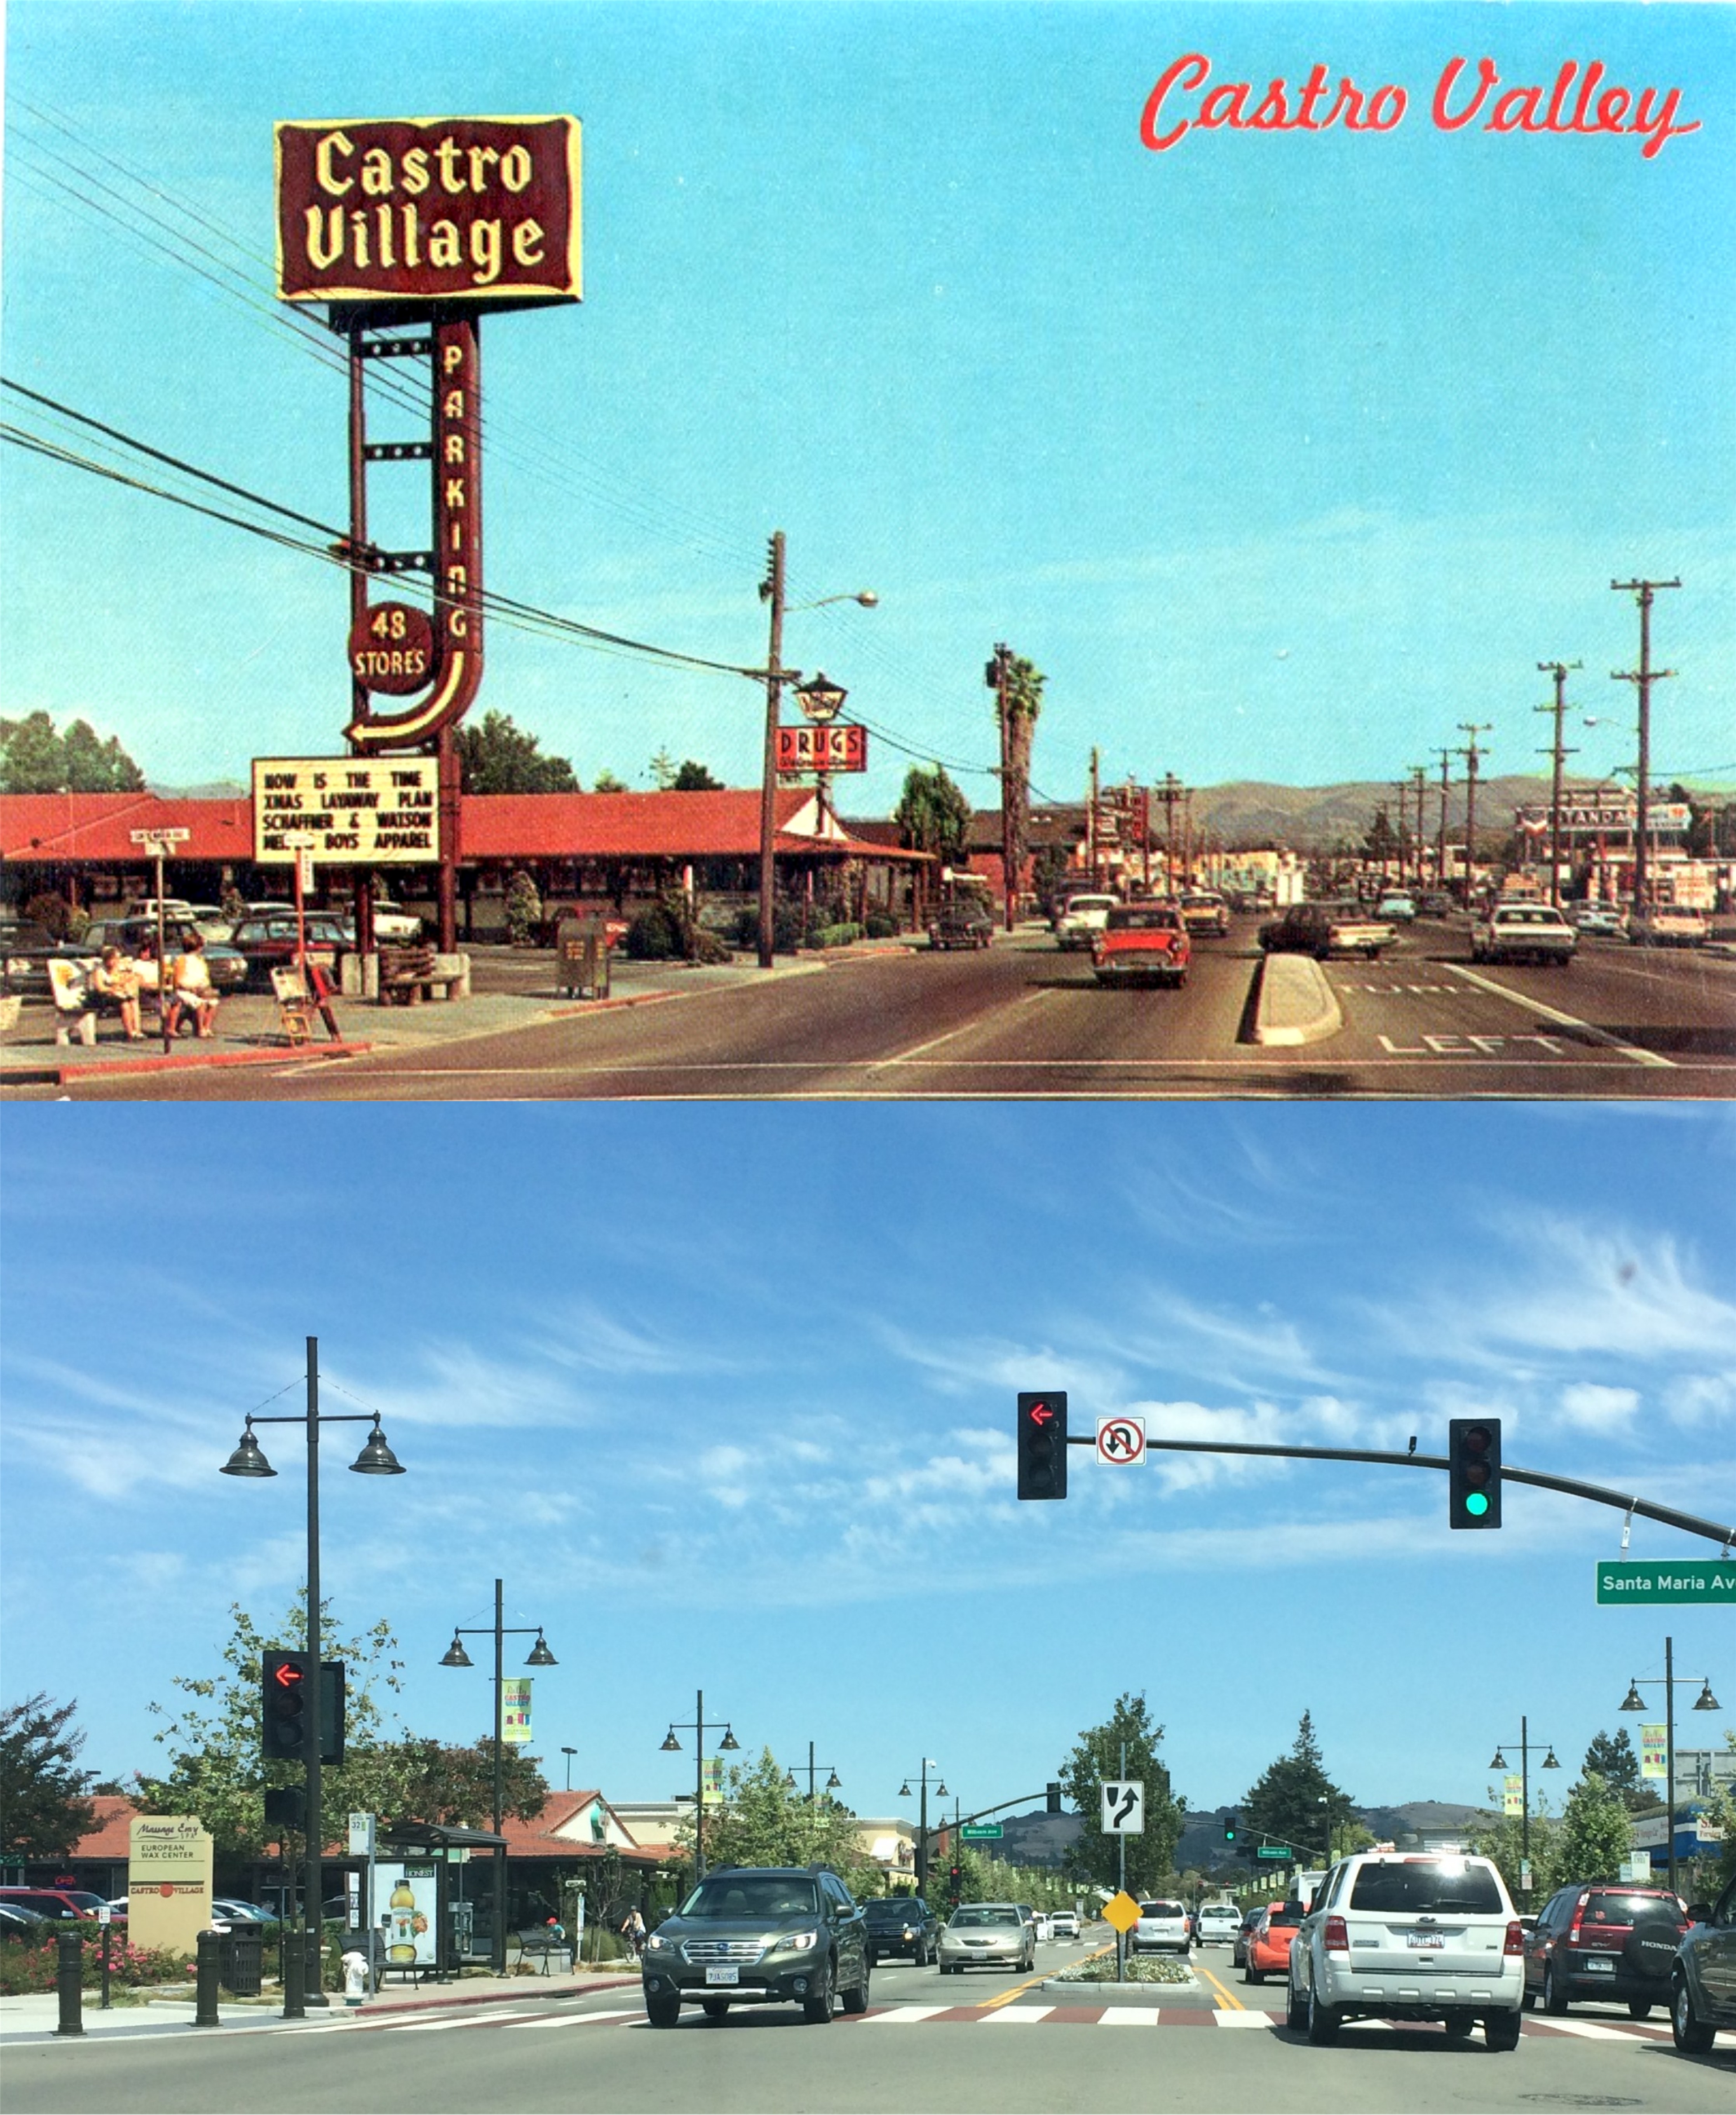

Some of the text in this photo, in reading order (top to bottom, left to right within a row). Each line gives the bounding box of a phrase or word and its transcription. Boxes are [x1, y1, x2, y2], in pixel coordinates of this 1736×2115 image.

[315, 131, 532, 196] Castro
[305, 202, 545, 284] Village
[371, 611, 406, 640] 48
[355, 649, 425, 677] STORES
[781, 730, 858, 753] DRUGS
[265, 771, 422, 789] NOW IS THE TIME
[265, 791, 433, 810] XMAS LAYAWAY PLAN
[349, 812, 360, 829] &
[376, 812, 432, 828] WATSON
[325, 832, 359, 850] BOYS
[374, 832, 431, 849] APPAREL
[1377, 1035, 1564, 1055] LEFT
[1603, 1575, 1736, 1590] Santa Maria Av
[136, 1824, 174, 1836] Massage
[1641, 1940, 1678, 1951] HONDA
